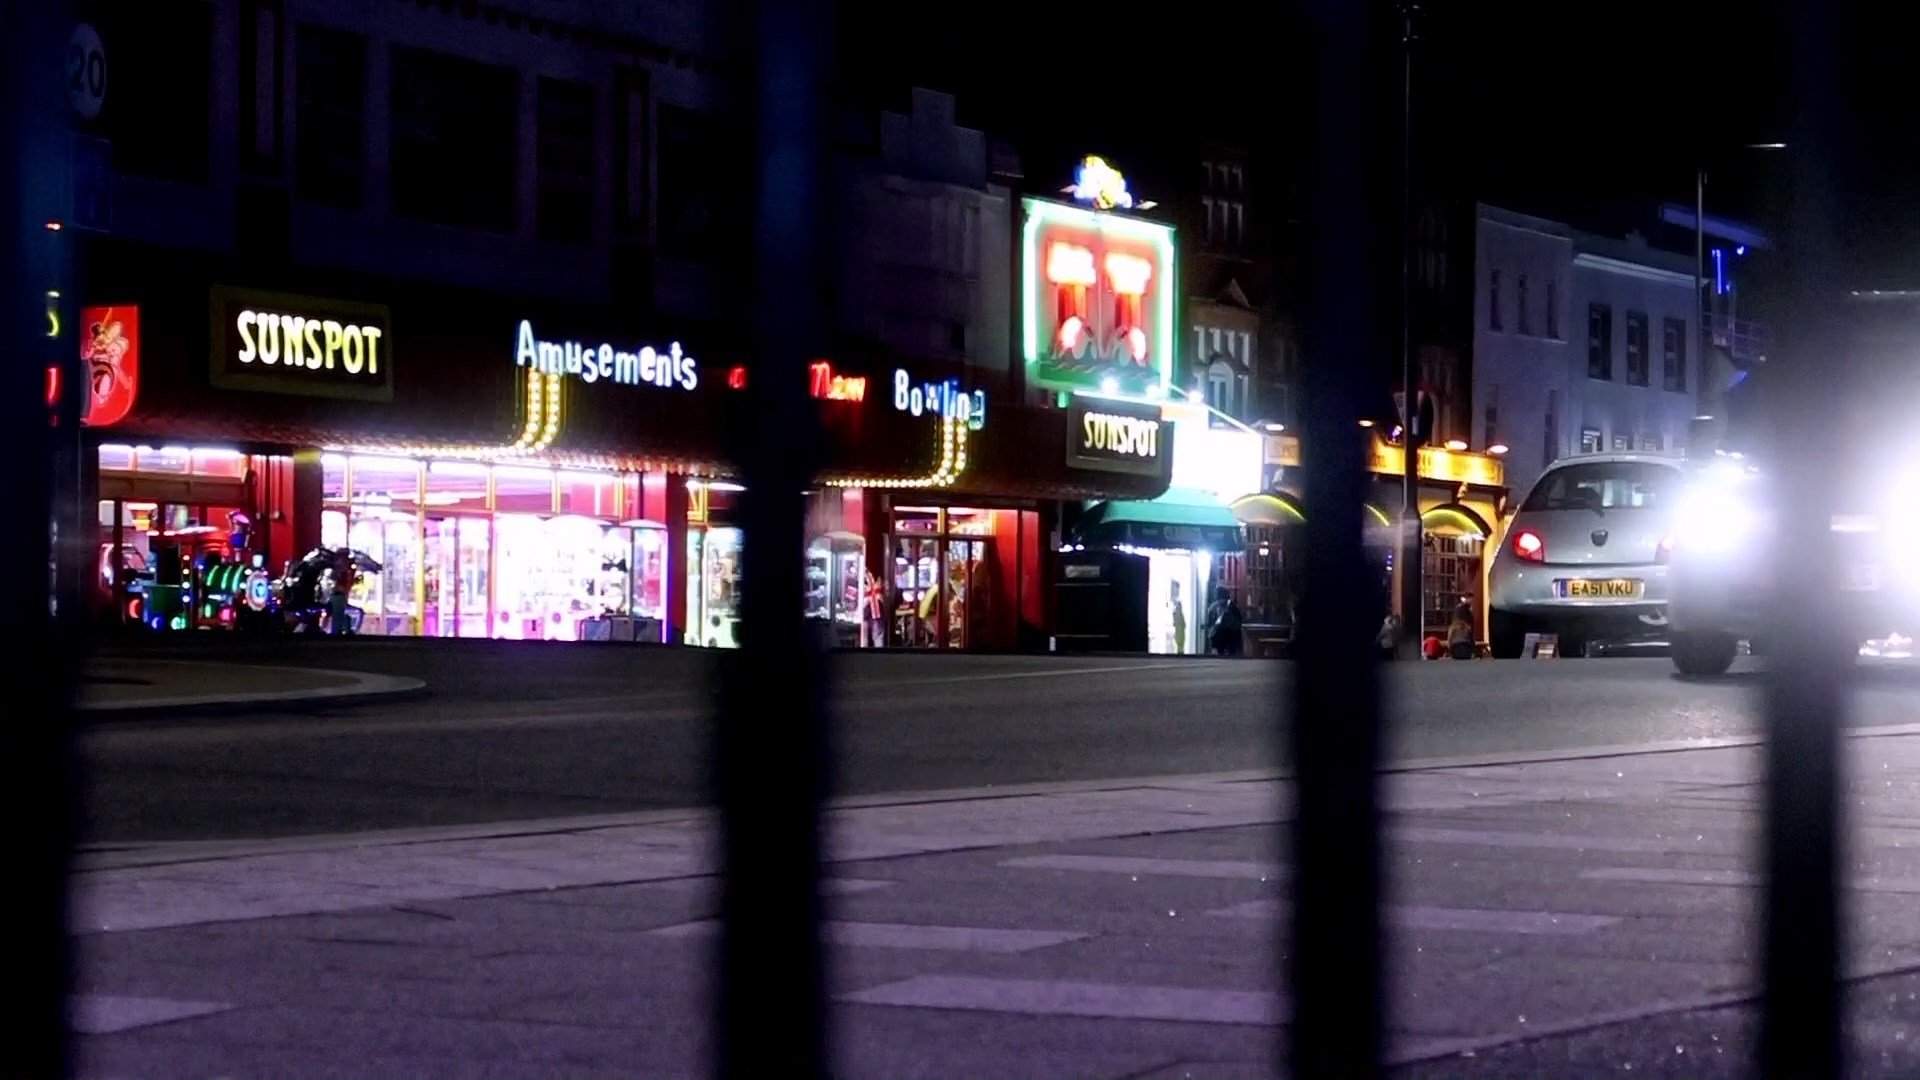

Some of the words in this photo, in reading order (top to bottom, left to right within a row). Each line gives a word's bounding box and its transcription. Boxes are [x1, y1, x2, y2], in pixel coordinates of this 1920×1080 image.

[69, 45, 105, 98] 20
[237, 310, 382, 374] SUNSPOT
[516, 319, 698, 391] Amusements
[895, 368, 985, 431] Bowling
[1083, 411, 1159, 457] SUNSPOT
[1606, 581, 1633, 595] VKU
